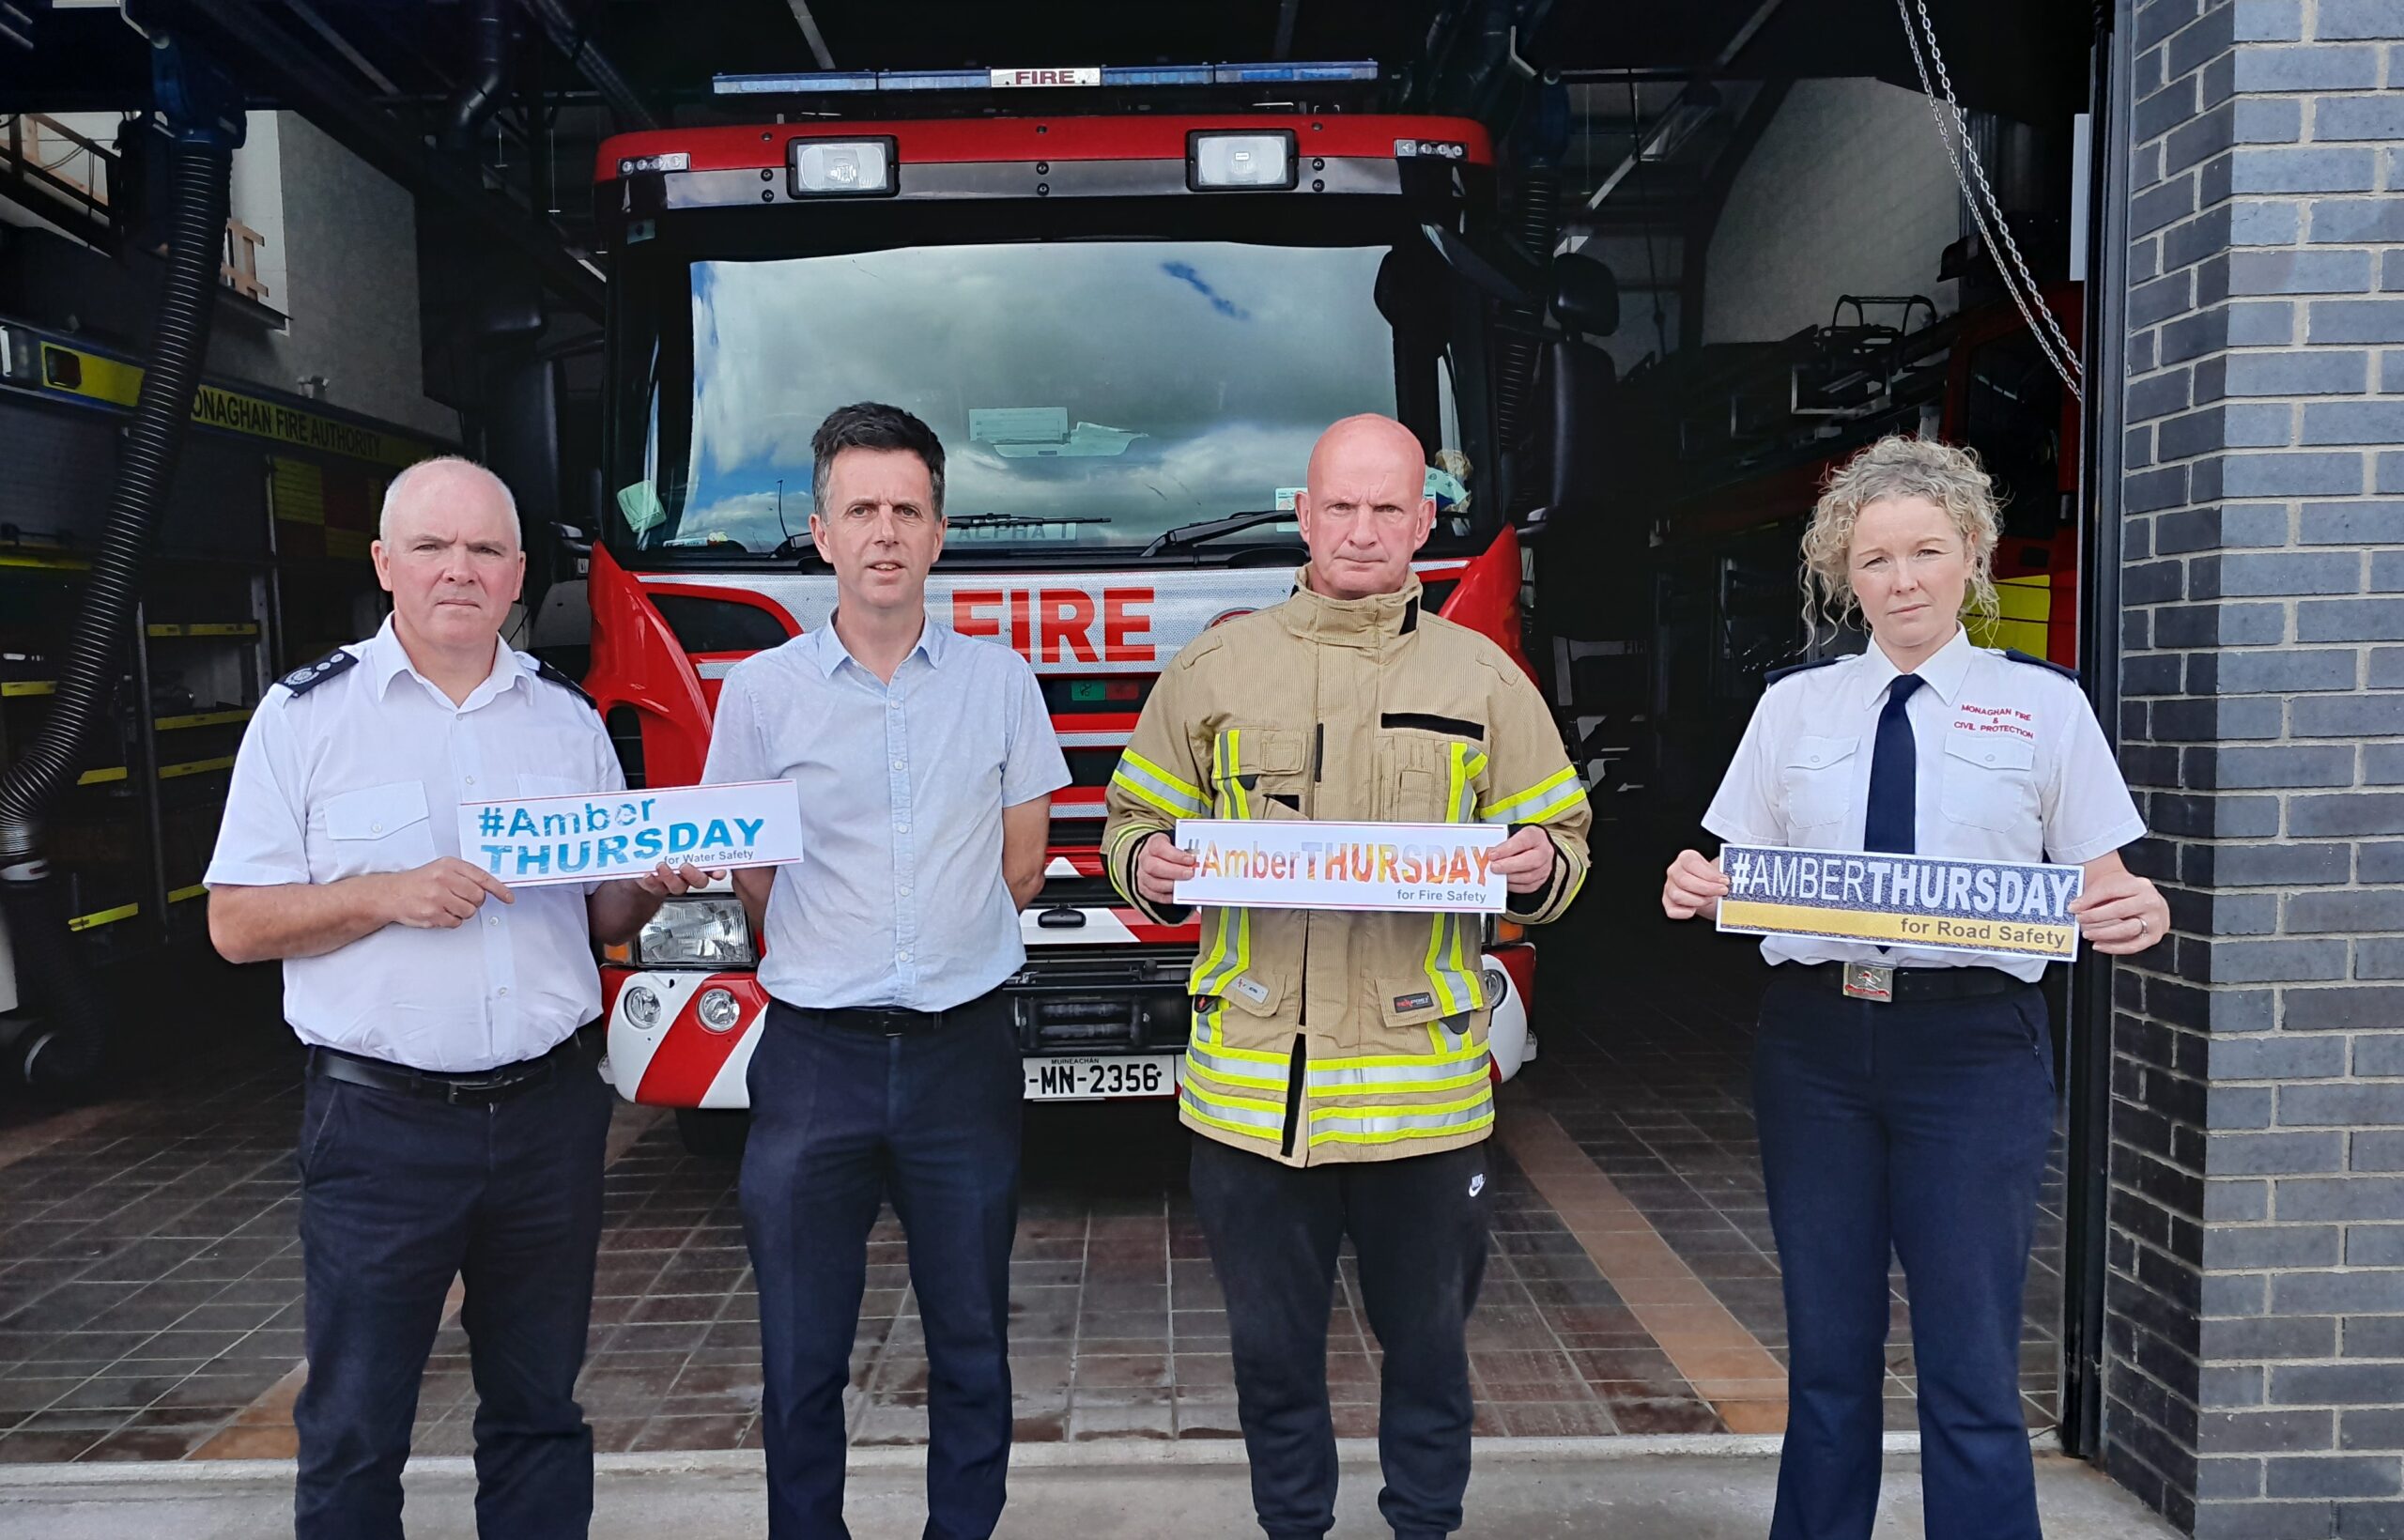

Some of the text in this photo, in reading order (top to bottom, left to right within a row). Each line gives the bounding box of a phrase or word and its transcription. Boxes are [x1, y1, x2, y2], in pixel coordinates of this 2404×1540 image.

[1015, 70, 1075, 85] FIRE
[193, 389, 381, 457] ONAGHAN FIRE AUTHORITY
[952, 587, 1156, 663] FIRE
[1953, 721, 2034, 739] CIVIL PROTECTION
[1961, 704, 2031, 721] MONAGHAN FIRE
[477, 798, 656, 838] #Amber
[480, 818, 764, 875] THURSDAY
[663, 848, 755, 865] for Water Safety
[1184, 839, 1496, 886] #AmberTHURSDAY
[1397, 888, 1487, 904] for Fire Safety
[1732, 853, 2076, 917] #AMBERTHURSDAY
[1901, 917, 2067, 948] for Road Safety
